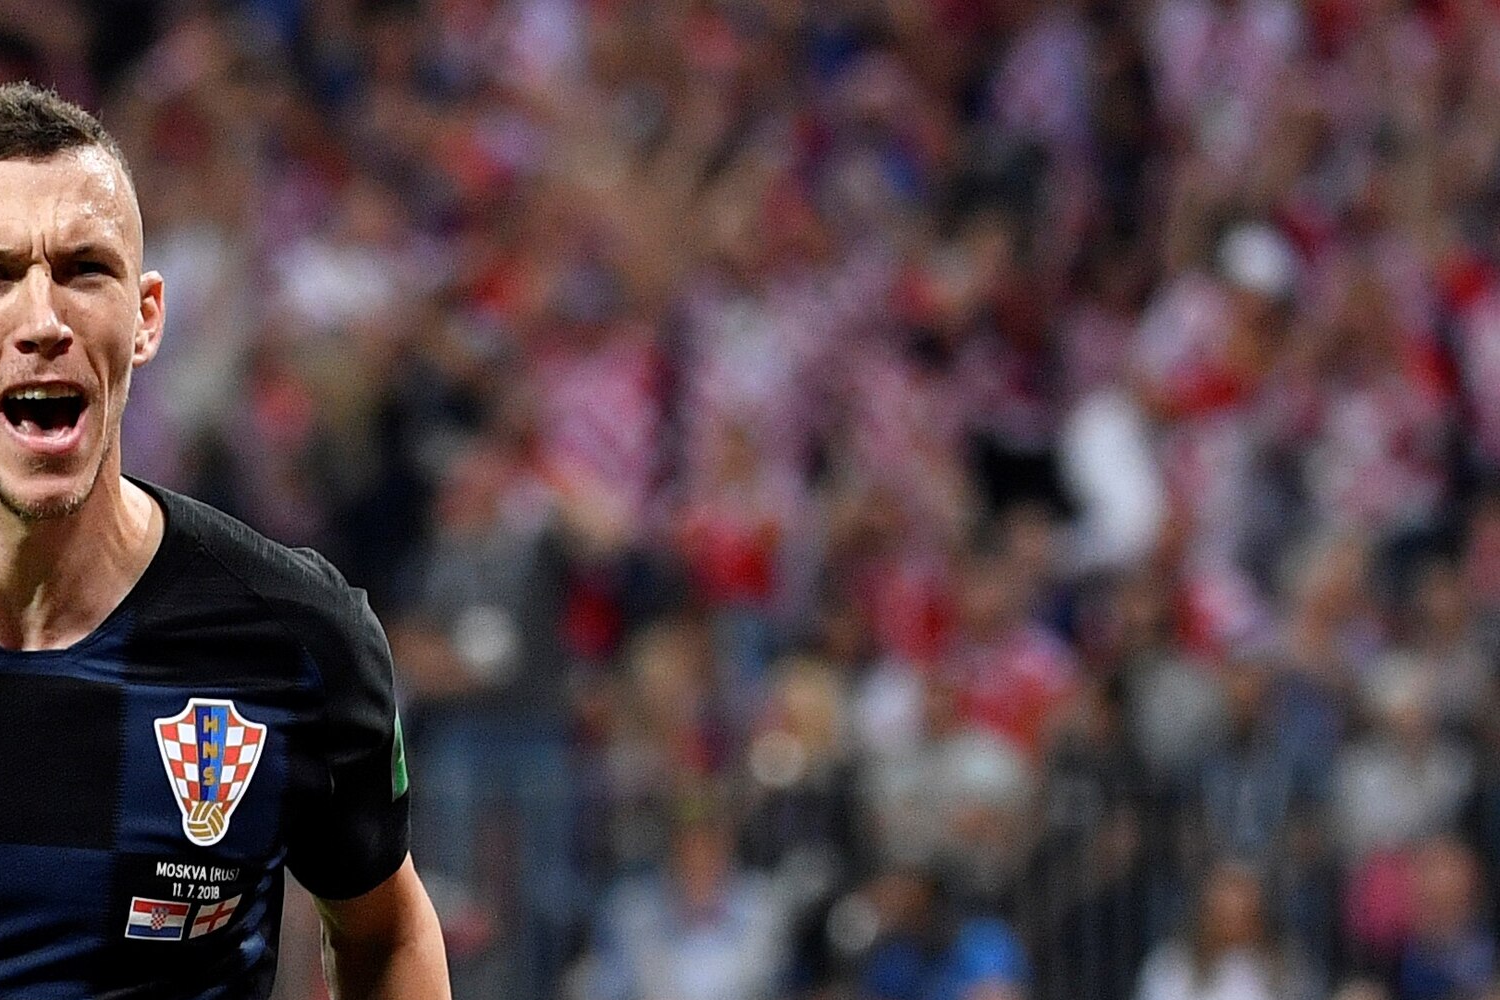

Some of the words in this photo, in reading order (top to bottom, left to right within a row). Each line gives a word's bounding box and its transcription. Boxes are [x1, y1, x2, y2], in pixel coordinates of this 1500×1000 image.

[203, 715, 219, 787] HNS
[156, 861, 207, 881] MOSKVA
[209, 866, 240, 882] (RUS)
[197, 885, 220, 900] 2018
